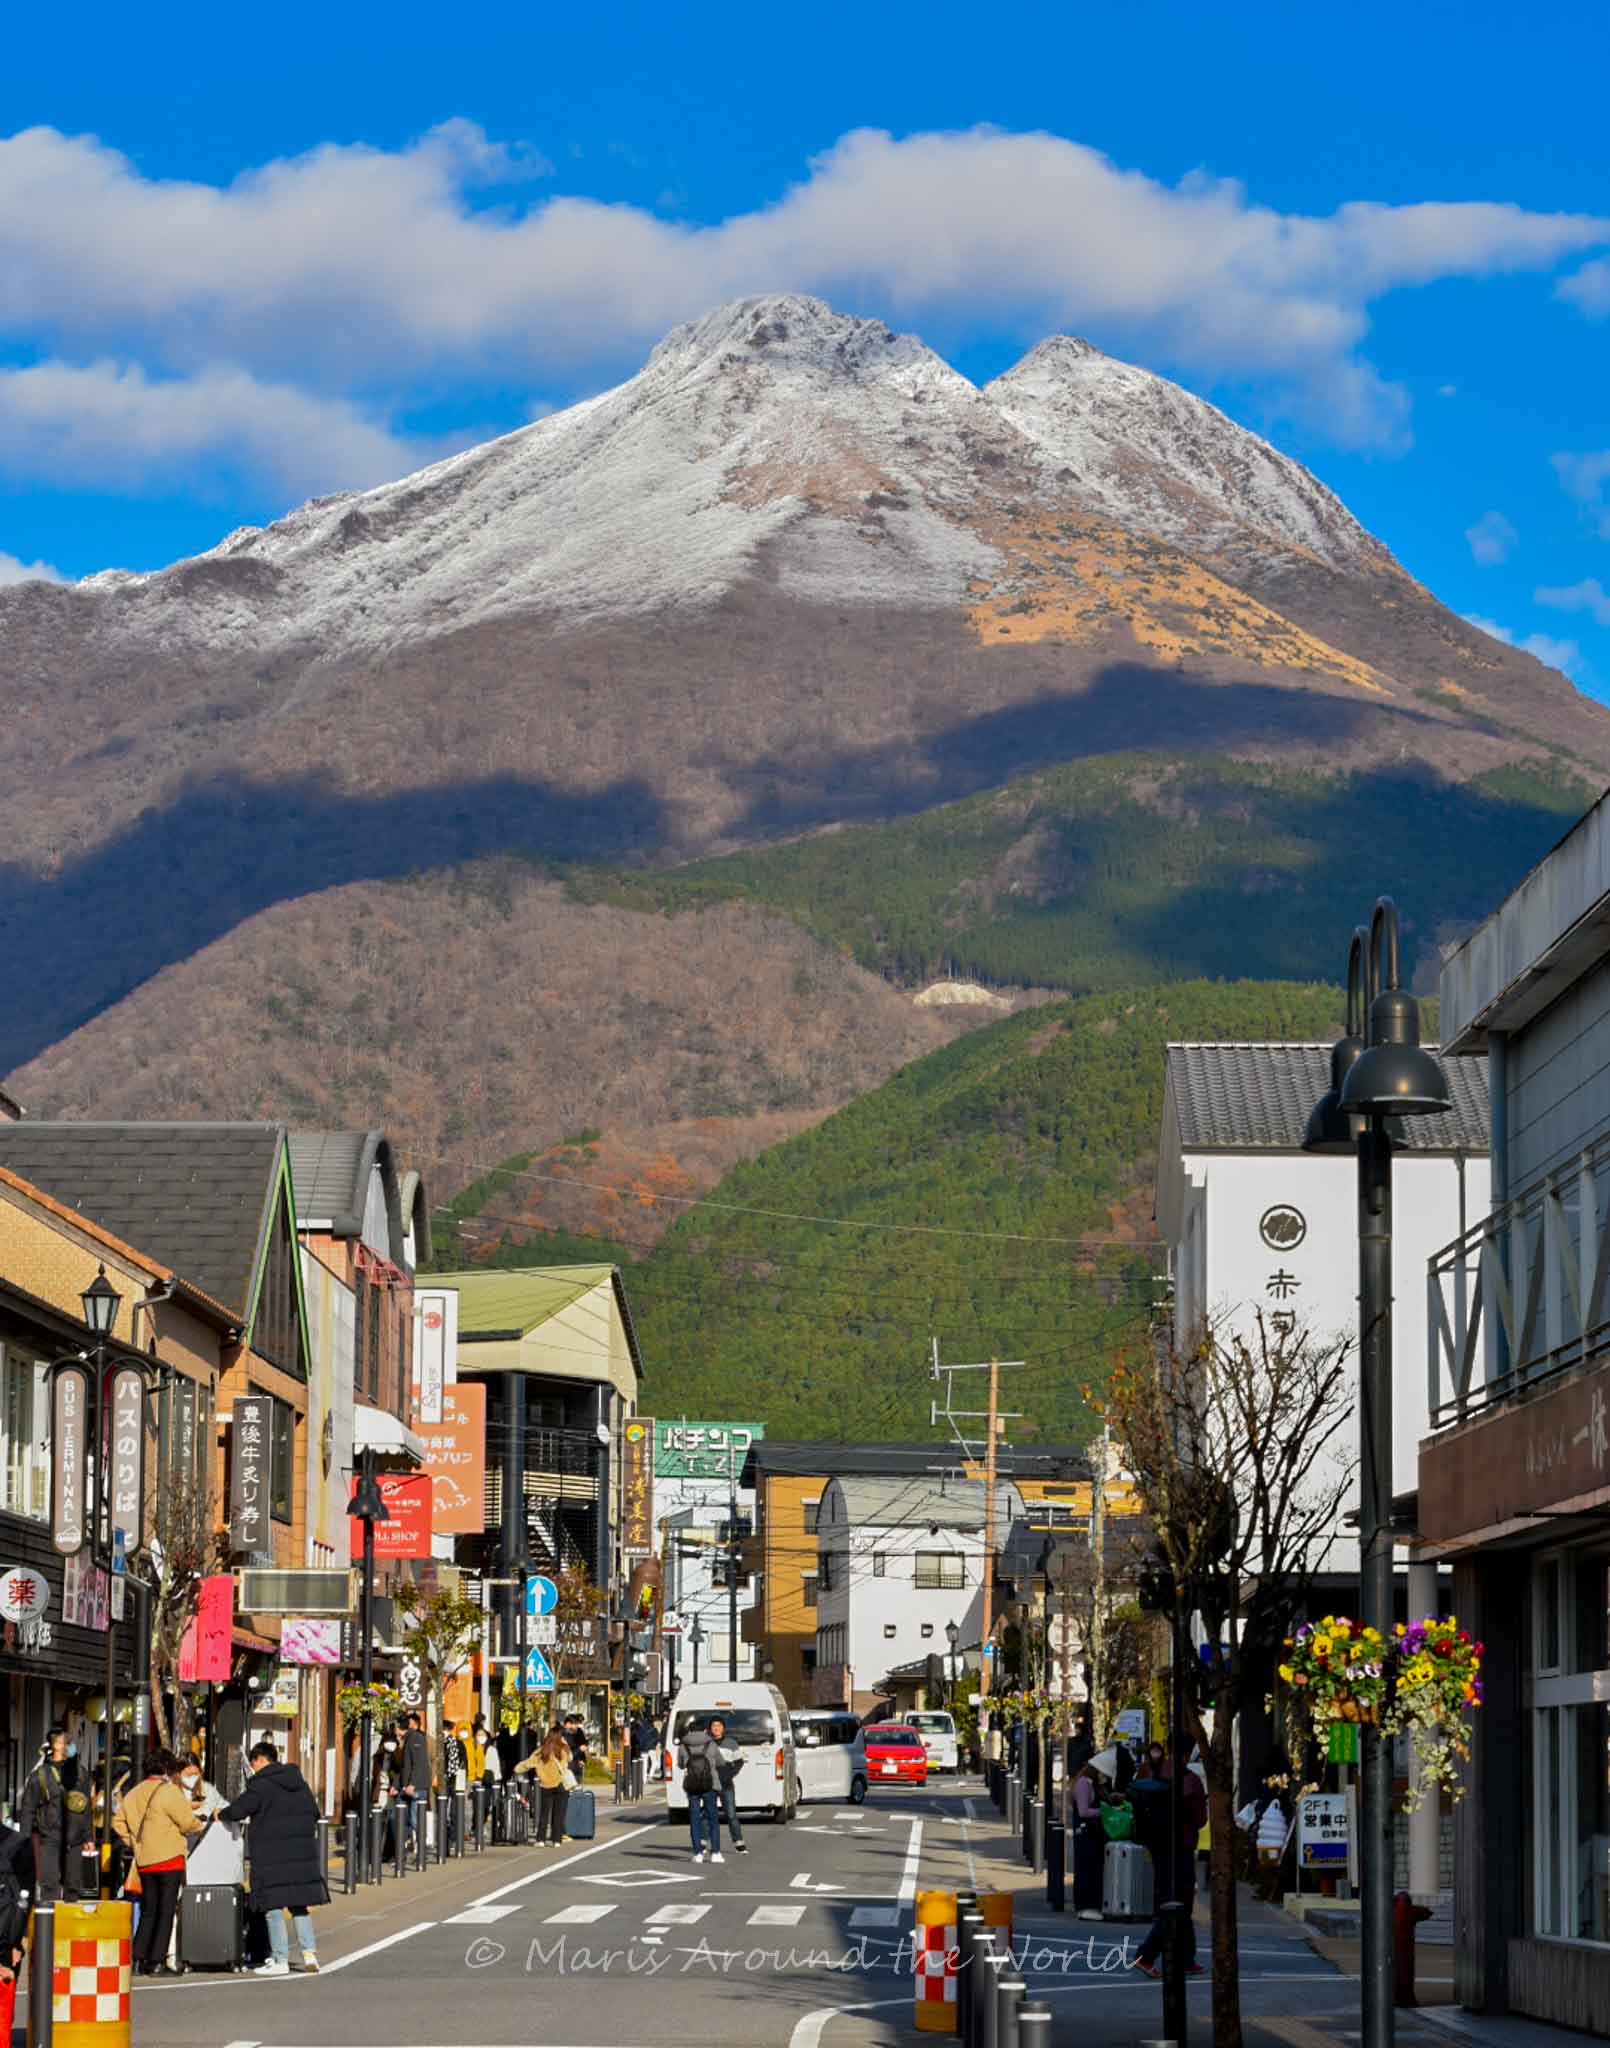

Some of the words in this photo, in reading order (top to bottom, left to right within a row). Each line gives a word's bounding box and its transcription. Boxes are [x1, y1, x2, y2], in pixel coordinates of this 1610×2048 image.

[64, 1380, 76, 1418] BUS
[115, 1381, 139, 1513] バスのりば
[662, 1427, 752, 1451] パチンコ
[63, 1423, 75, 1523] TERMINAL
[8, 1577, 37, 1606] 薬
[1303, 1800, 1321, 1812] 2F
[1303, 1813, 1348, 1828] 営業中
